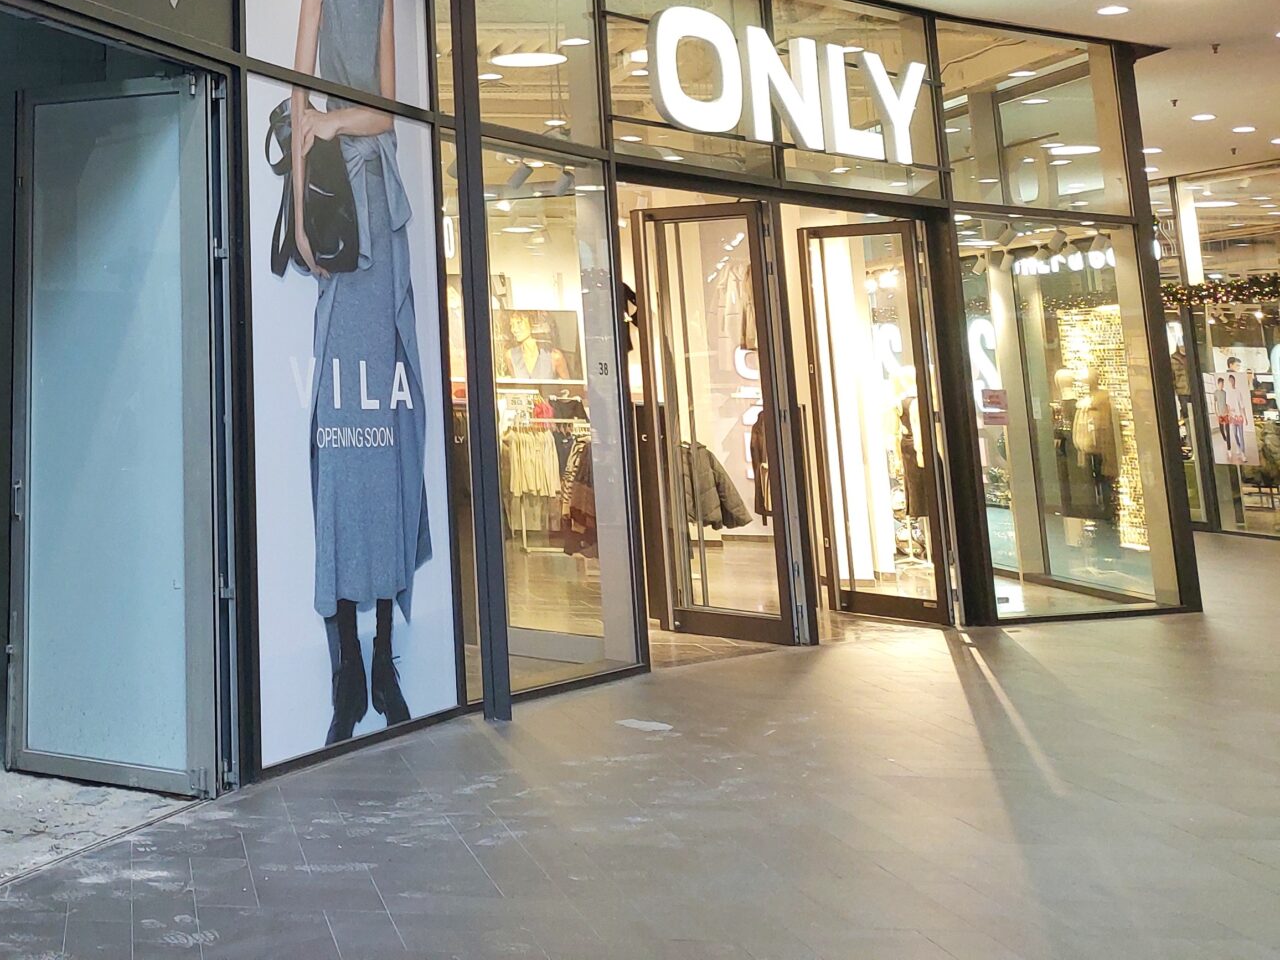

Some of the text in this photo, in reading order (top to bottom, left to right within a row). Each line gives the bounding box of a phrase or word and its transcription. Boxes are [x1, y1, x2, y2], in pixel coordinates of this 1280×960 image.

[647, 5, 927, 165] ONLY
[289, 355, 414, 410] VILA
[598, 362, 609, 376] 38
[316, 426, 394, 449] OPENING SOON
